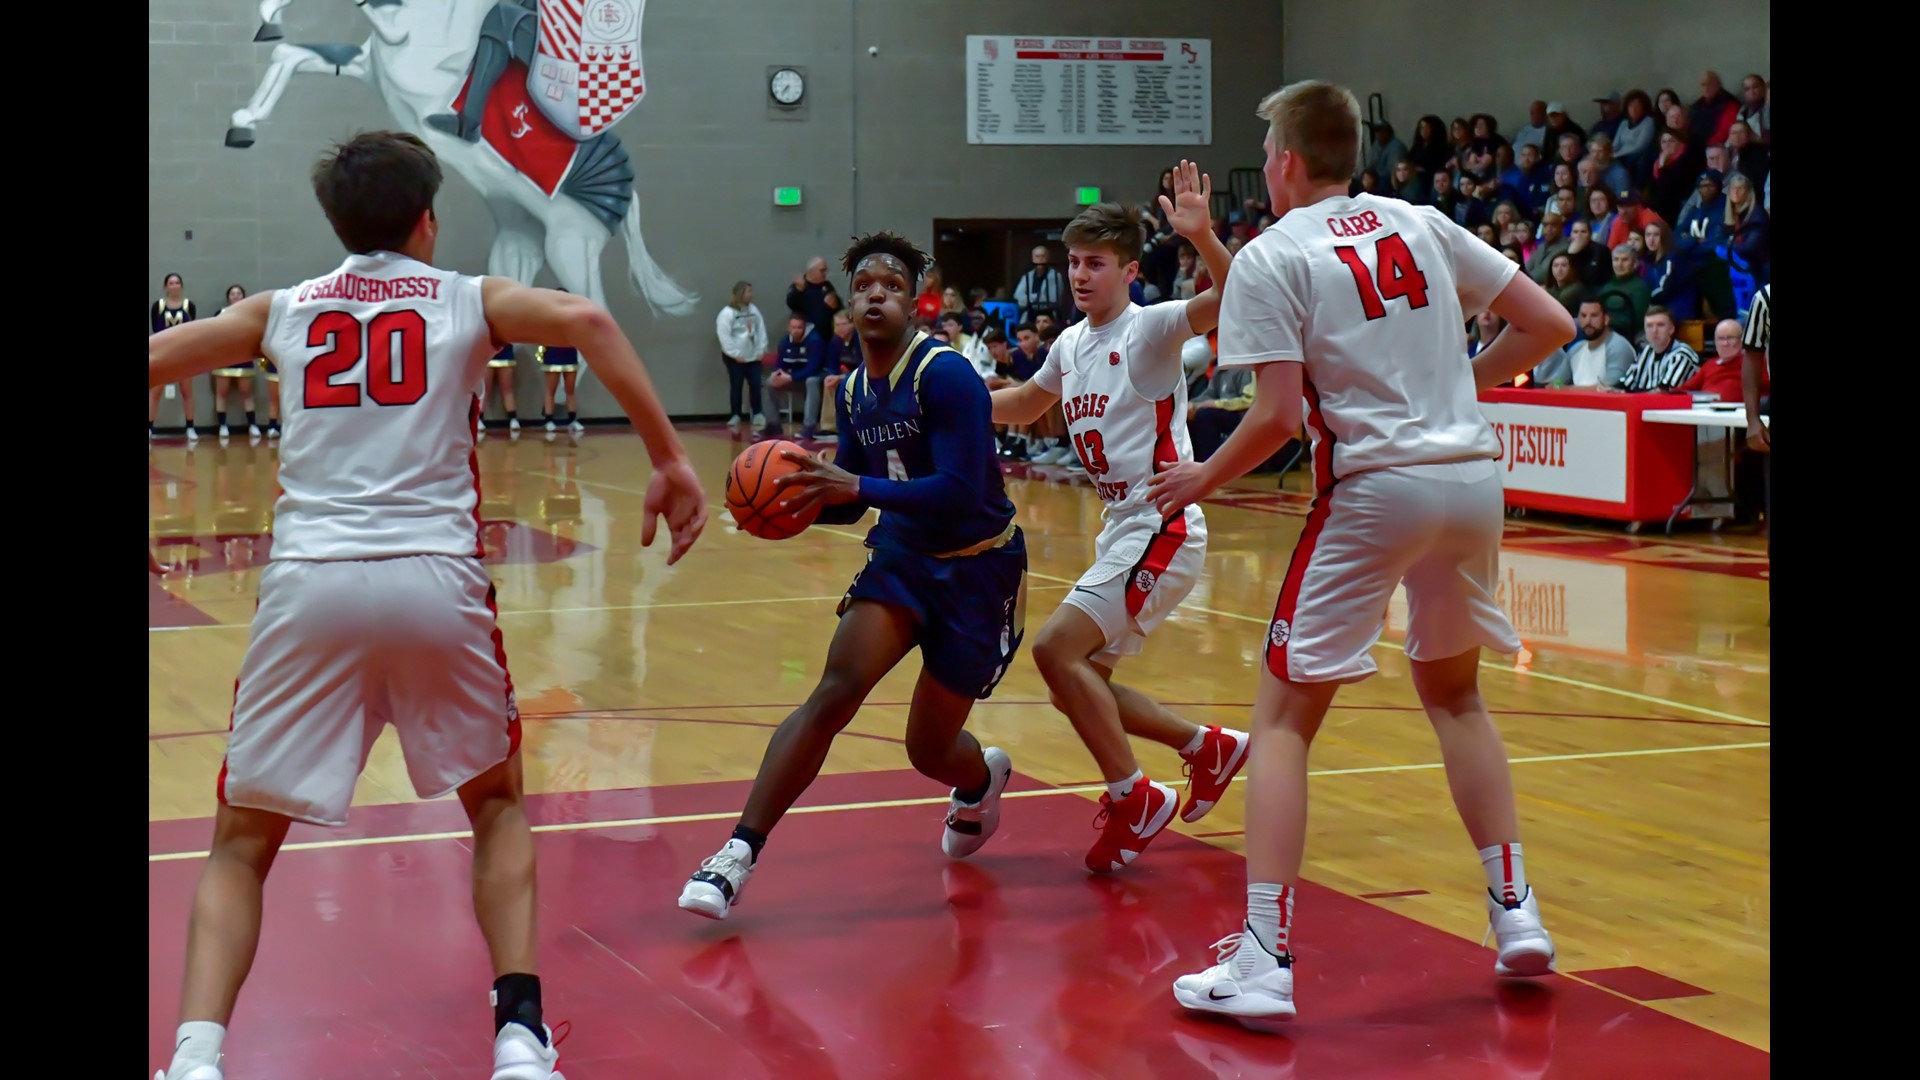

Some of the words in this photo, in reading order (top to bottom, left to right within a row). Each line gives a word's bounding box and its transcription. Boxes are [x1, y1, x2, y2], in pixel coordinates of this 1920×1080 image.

[1327, 210, 1383, 237] CARR
[1333, 232, 1429, 321] 14
[304, 309, 427, 409] 20
[856, 418, 921, 446] MULLEN
[1064, 393, 1110, 426] REGIS
[1073, 429, 1110, 475] 13
[1508, 423, 1567, 472] JESUIT
